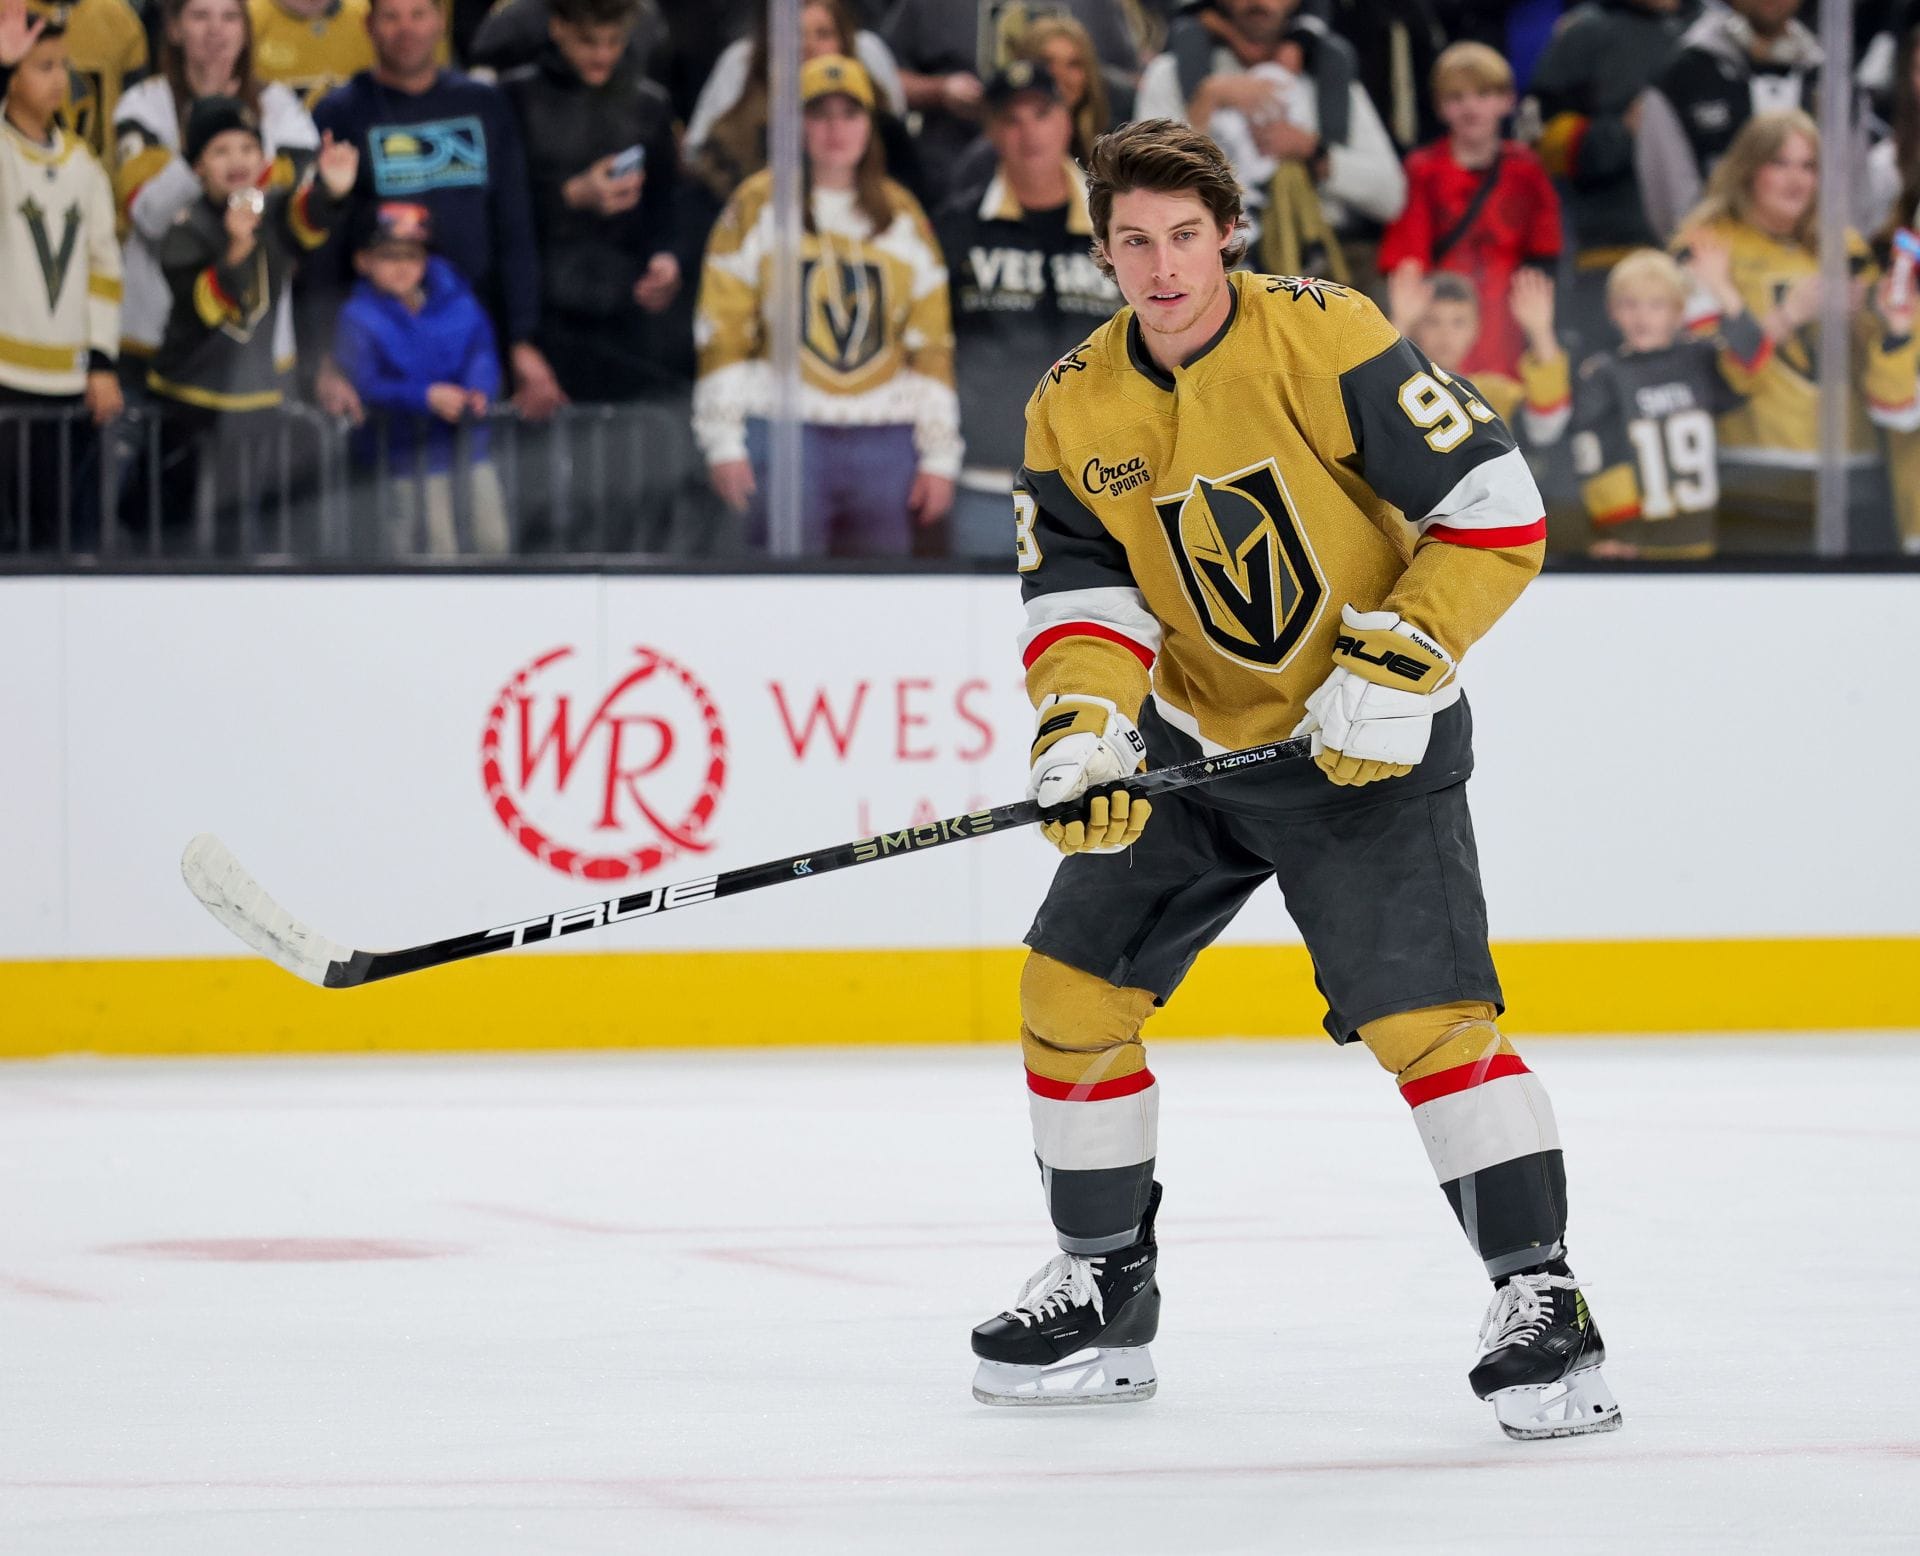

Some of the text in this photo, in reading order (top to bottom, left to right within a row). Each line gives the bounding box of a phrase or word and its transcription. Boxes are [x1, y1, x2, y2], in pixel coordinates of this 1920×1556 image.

[1082, 457, 1145, 494] Circa
[1109, 469, 1151, 497] SPORTS
[1629, 409, 1719, 519] 19
[1333, 635, 1432, 682] RUE
[1409, 632, 1443, 660] MARNER
[767, 680, 1025, 761] WES
[1125, 729, 1145, 753] 93
[517, 662, 716, 852] WR
[1216, 748, 1277, 771] HZRDUS
[852, 809, 994, 862] SMOKE
[484, 875, 718, 947] TRUE
[1121, 1254, 1149, 1273] TRUE
